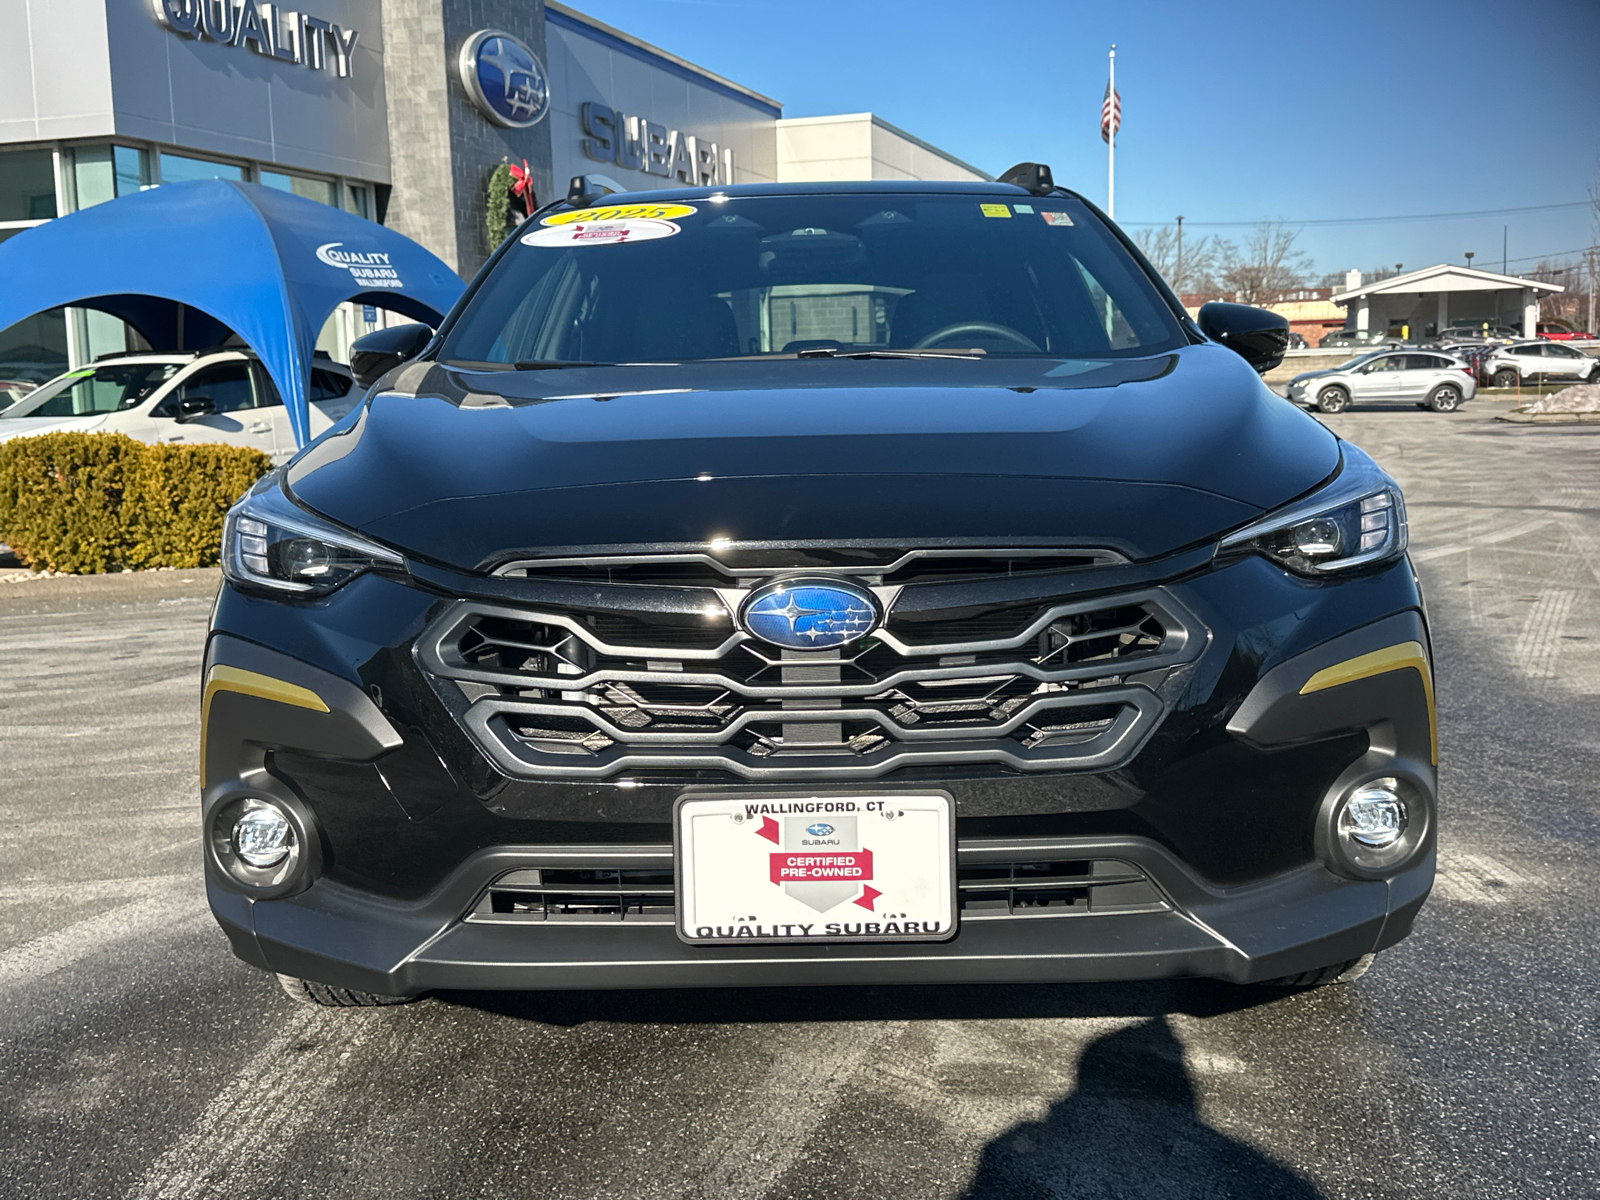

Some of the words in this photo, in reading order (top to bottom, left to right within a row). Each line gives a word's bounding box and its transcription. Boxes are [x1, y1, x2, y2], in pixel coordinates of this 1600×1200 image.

[153, 0, 359, 77] QUALITY
[581, 102, 734, 186] SUBARU
[566, 206, 672, 224] 2025
[327, 250, 390, 265] QUALITY
[349, 267, 398, 279] SUBARU
[745, 802, 861, 815] WALLINGFORD,
[866, 801, 886, 812] CT
[786, 856, 856, 867] CERTIFIED
[780, 867, 863, 878] PRE-OWNED
[695, 923, 815, 938] QUALITY
[825, 921, 941, 936] SUBARU
